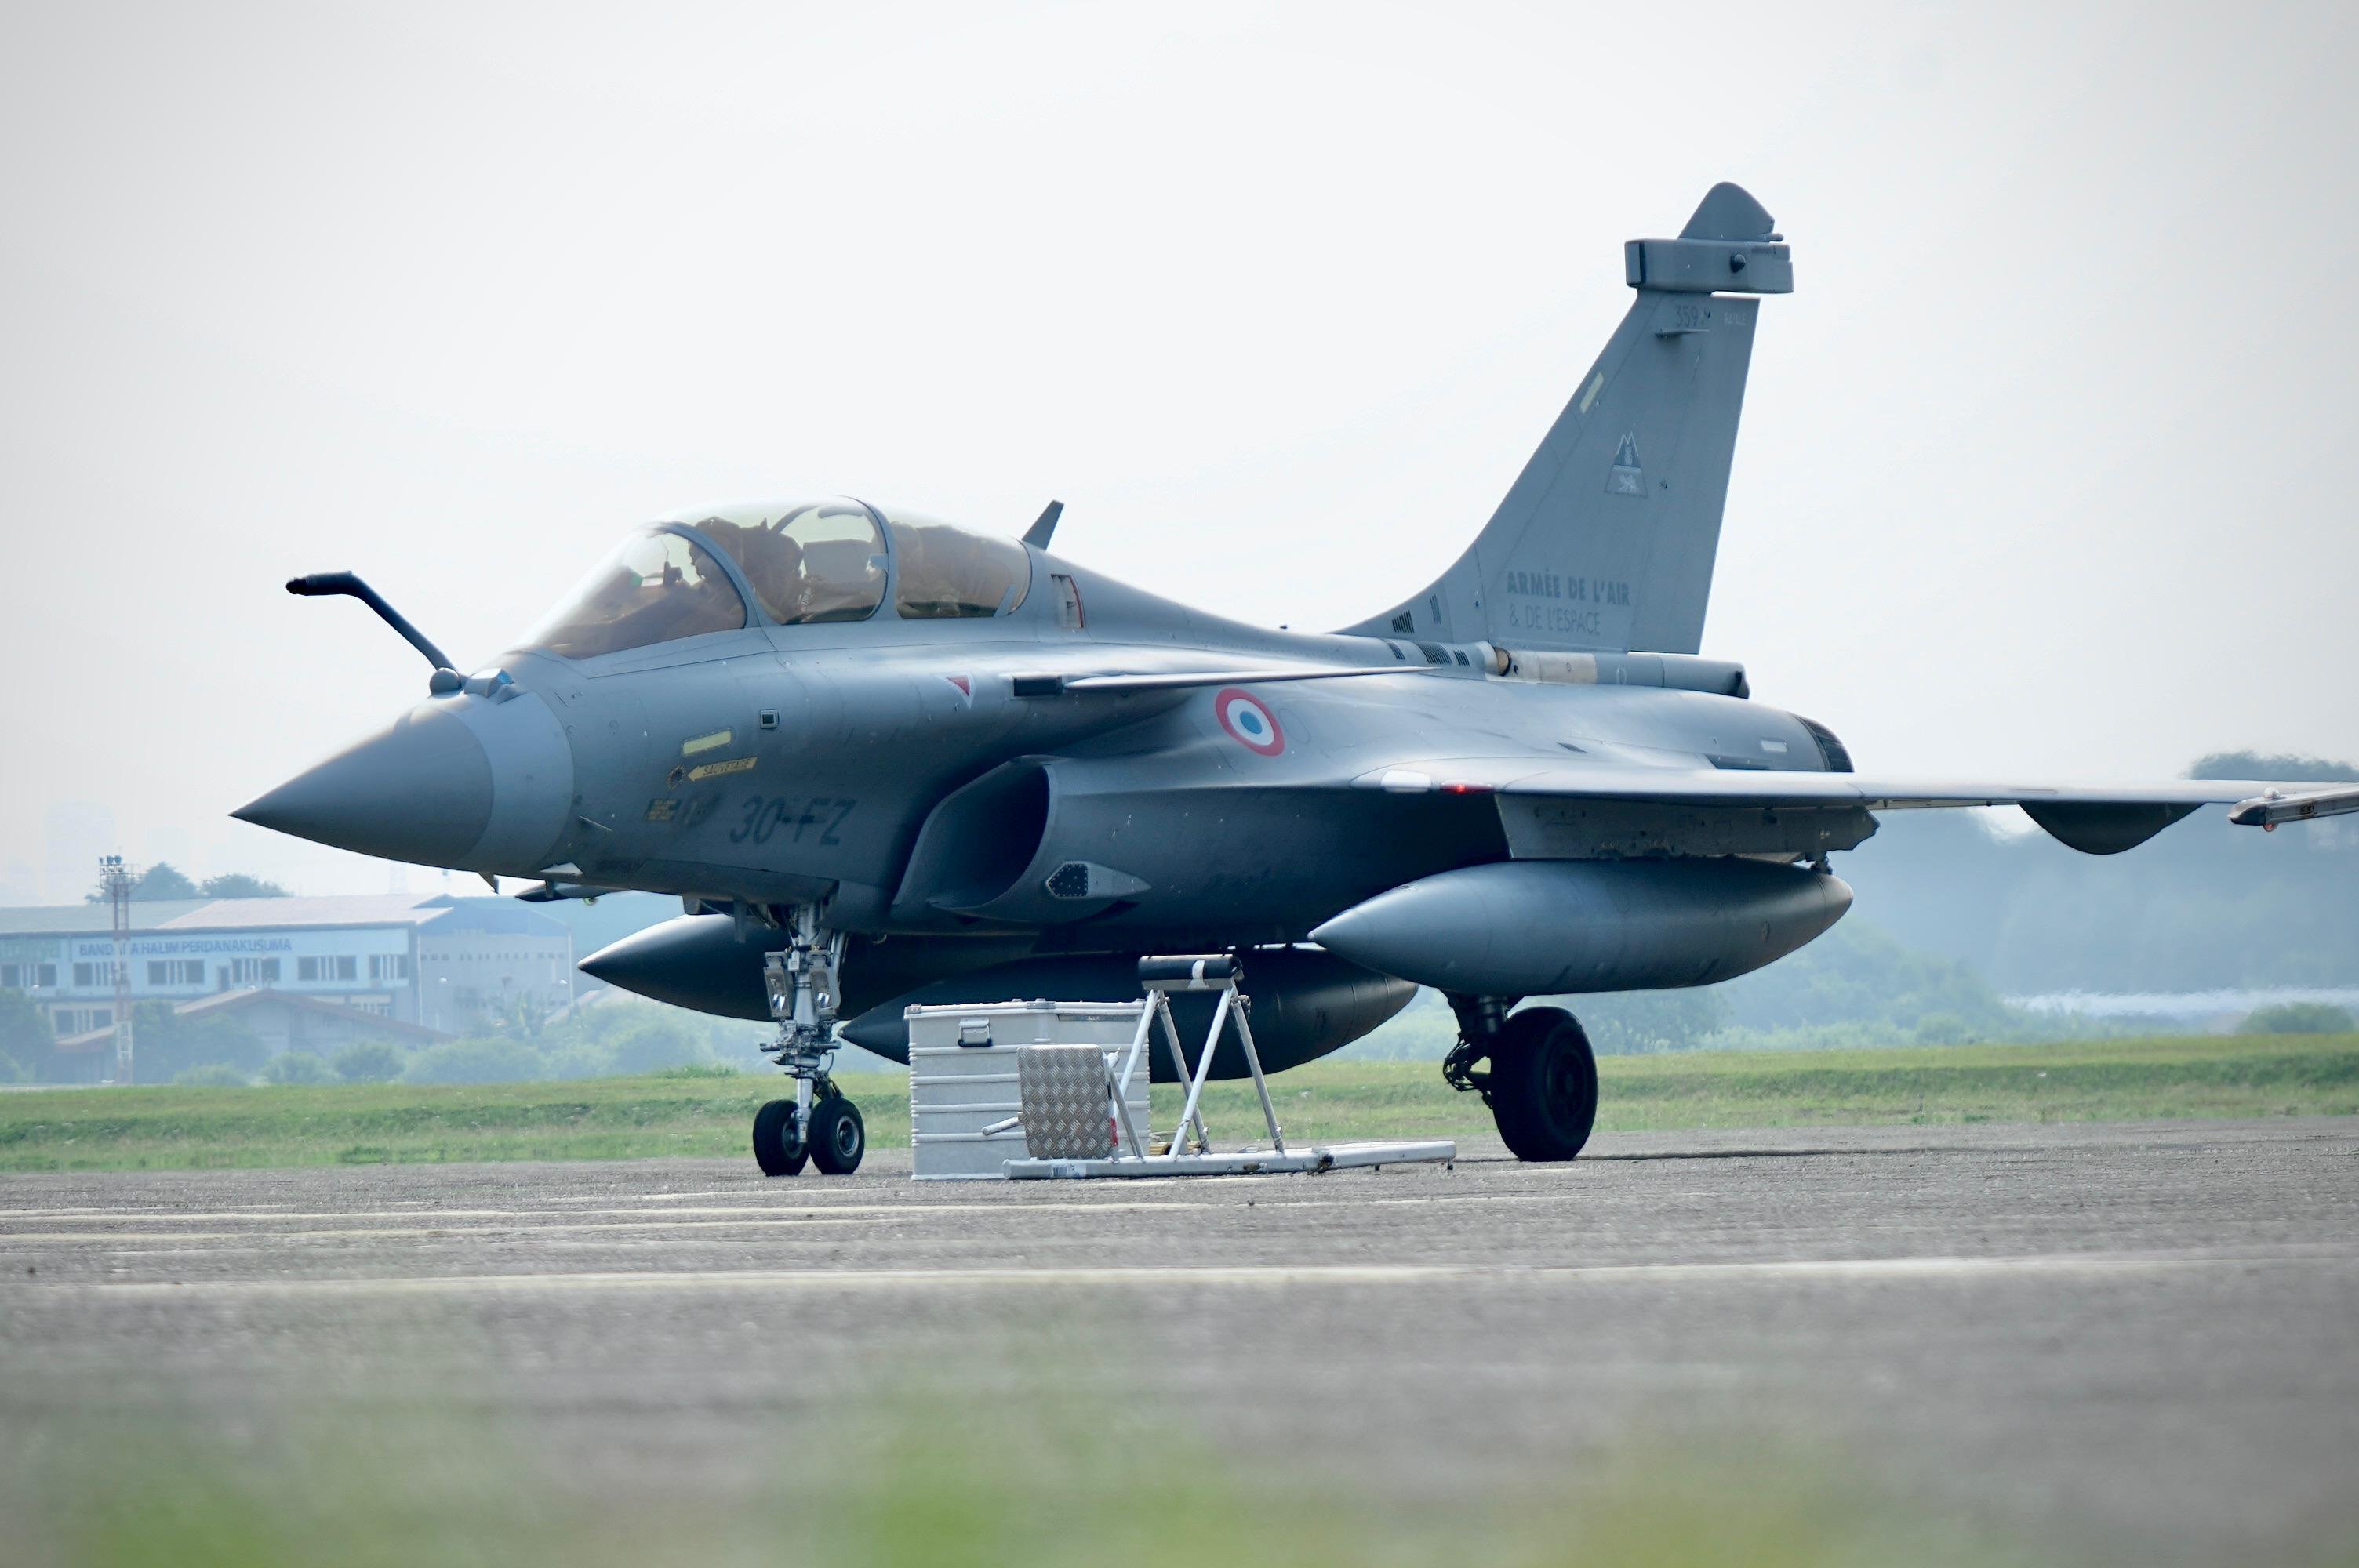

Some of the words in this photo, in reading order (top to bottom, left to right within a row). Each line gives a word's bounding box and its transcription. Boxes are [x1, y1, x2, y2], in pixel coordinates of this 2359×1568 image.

[1507, 567, 1561, 598] ARMÉE
[1568, 576, 1587, 601] DE
[1593, 579, 1630, 605] L'AIR
[1509, 603, 1520, 628] &
[1526, 604, 1543, 630] DE
[1547, 607, 1601, 636] L'ESPACE
[80, 942, 139, 956] BANDA
[142, 941, 178, 954] HALIM
